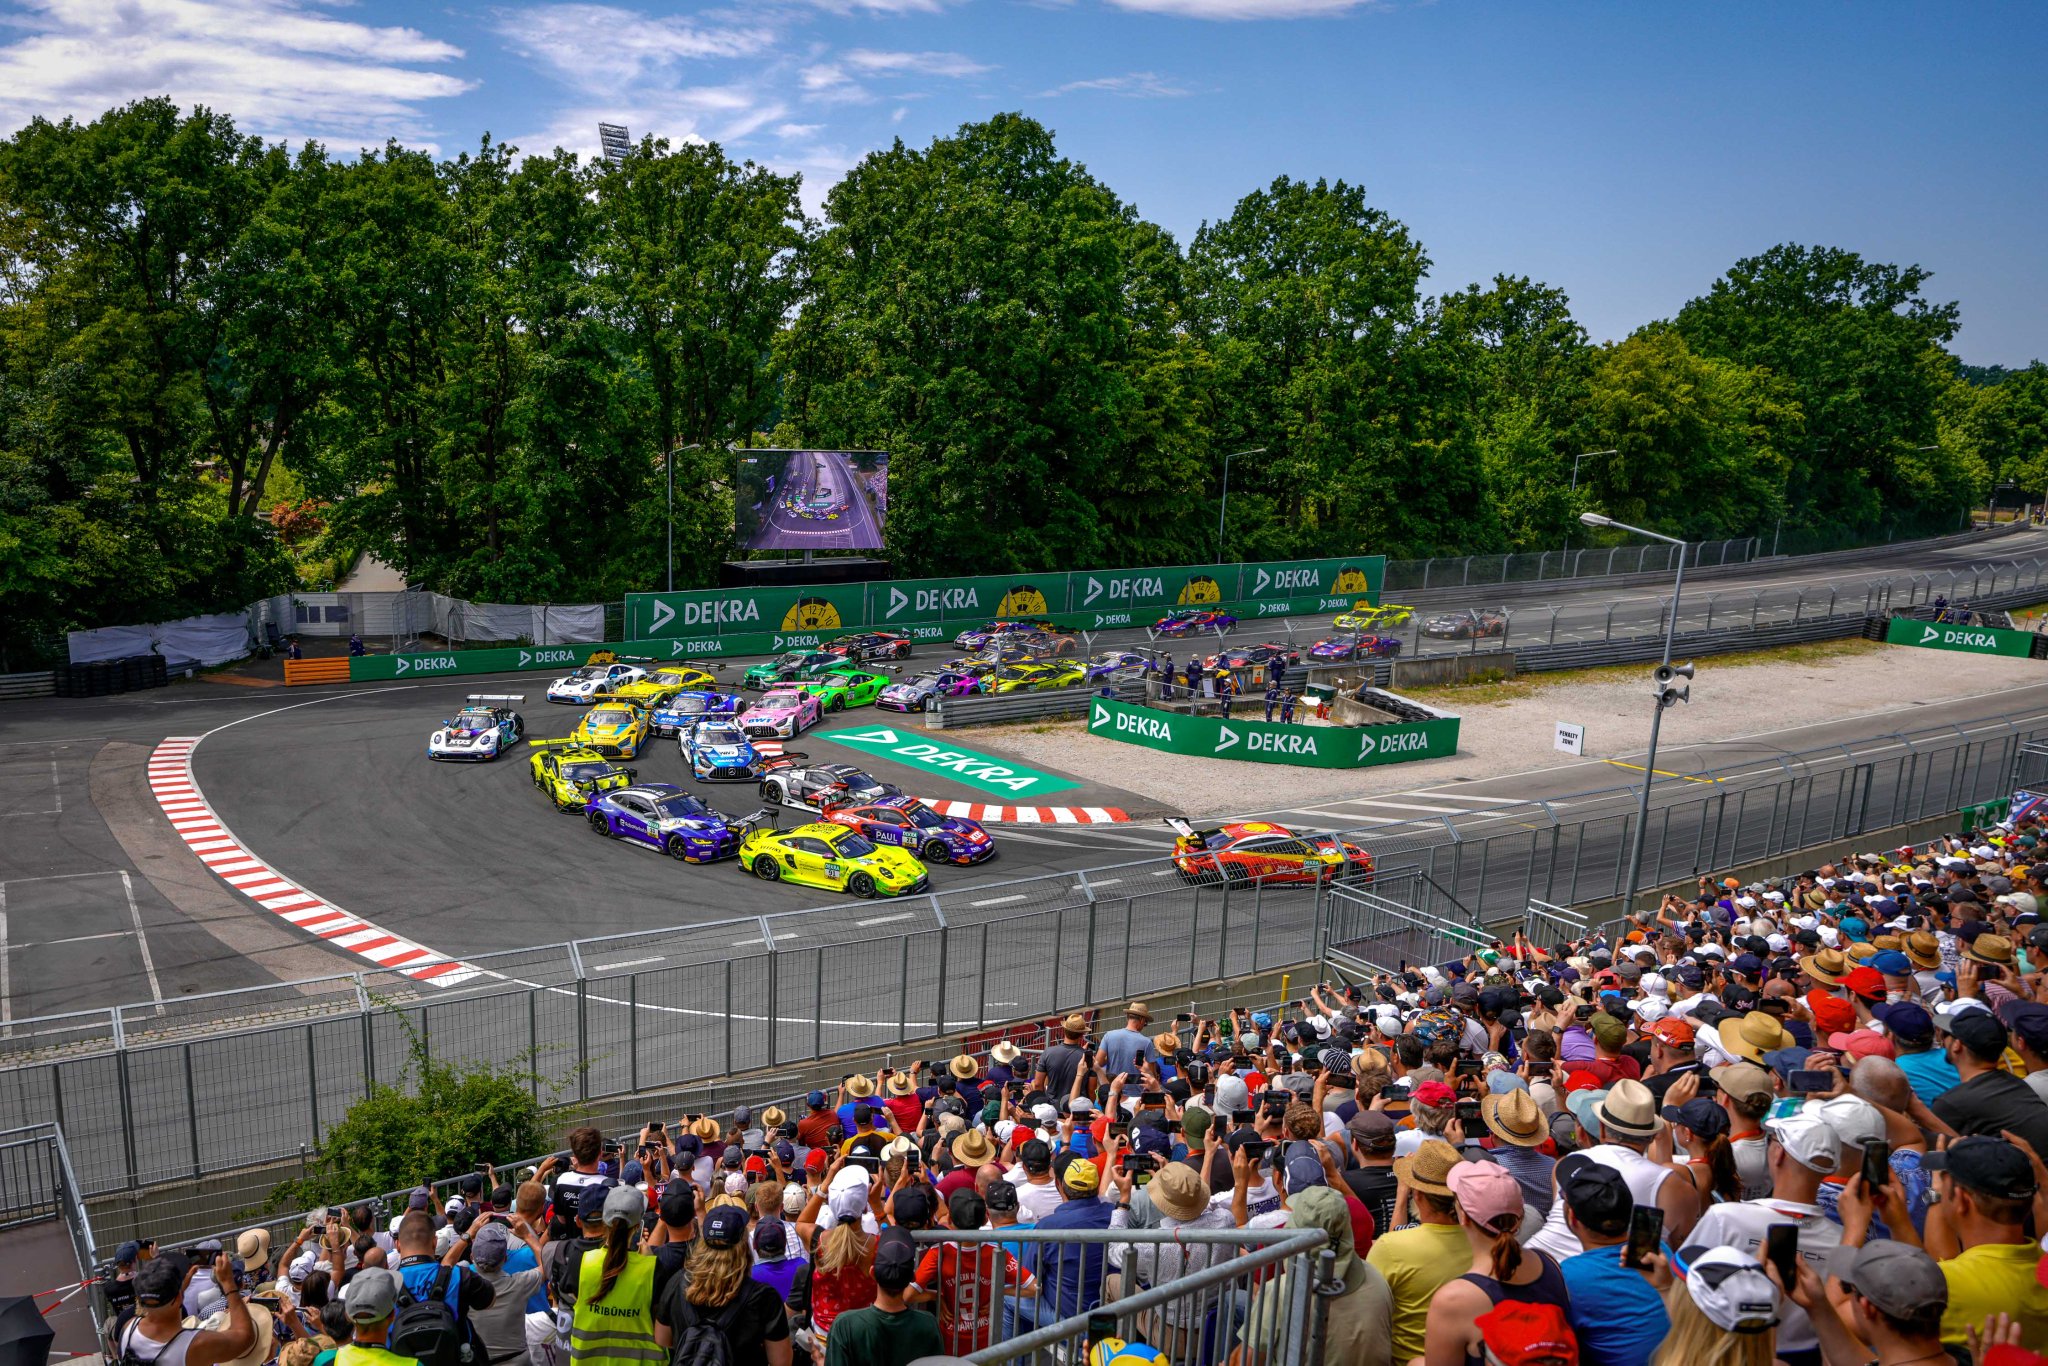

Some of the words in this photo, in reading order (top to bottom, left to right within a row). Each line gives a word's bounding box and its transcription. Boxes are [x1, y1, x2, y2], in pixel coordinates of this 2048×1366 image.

[1274, 568, 1319, 588] DEKRA
[1109, 577, 1164, 599] DEKRA
[1198, 582, 1204, 590] 12
[915, 588, 979, 612] DEKRA
[1020, 593, 1027, 602] 12
[1328, 598, 1348, 608] DEKRA
[684, 598, 760, 625] DEKRA
[1268, 603, 1290, 612] DEKRA
[809, 605, 817, 615] 12
[818, 608, 826, 617] 11
[825, 615, 834, 626] 10
[1106, 614, 1130, 624] DEKRA
[914, 627, 943, 638] DEKRA
[787, 635, 820, 647] DEKRA
[1944, 631, 1996, 648] DEKRA
[687, 640, 722, 653] DEKRA
[536, 650, 575, 663] DEKRA
[414, 657, 457, 670] DEKRA
[1116, 712, 1172, 742] DEKRA
[1559, 730, 1578, 739] PENALTY
[1248, 732, 1318, 756] DEKRA
[1379, 732, 1428, 754] DEKRA
[1562, 738, 1574, 746] ZONE
[891, 744, 1039, 791] DEKRA
[876, 830, 898, 842] PAUL
[588, 1302, 641, 1318] TRIBÜNEN
